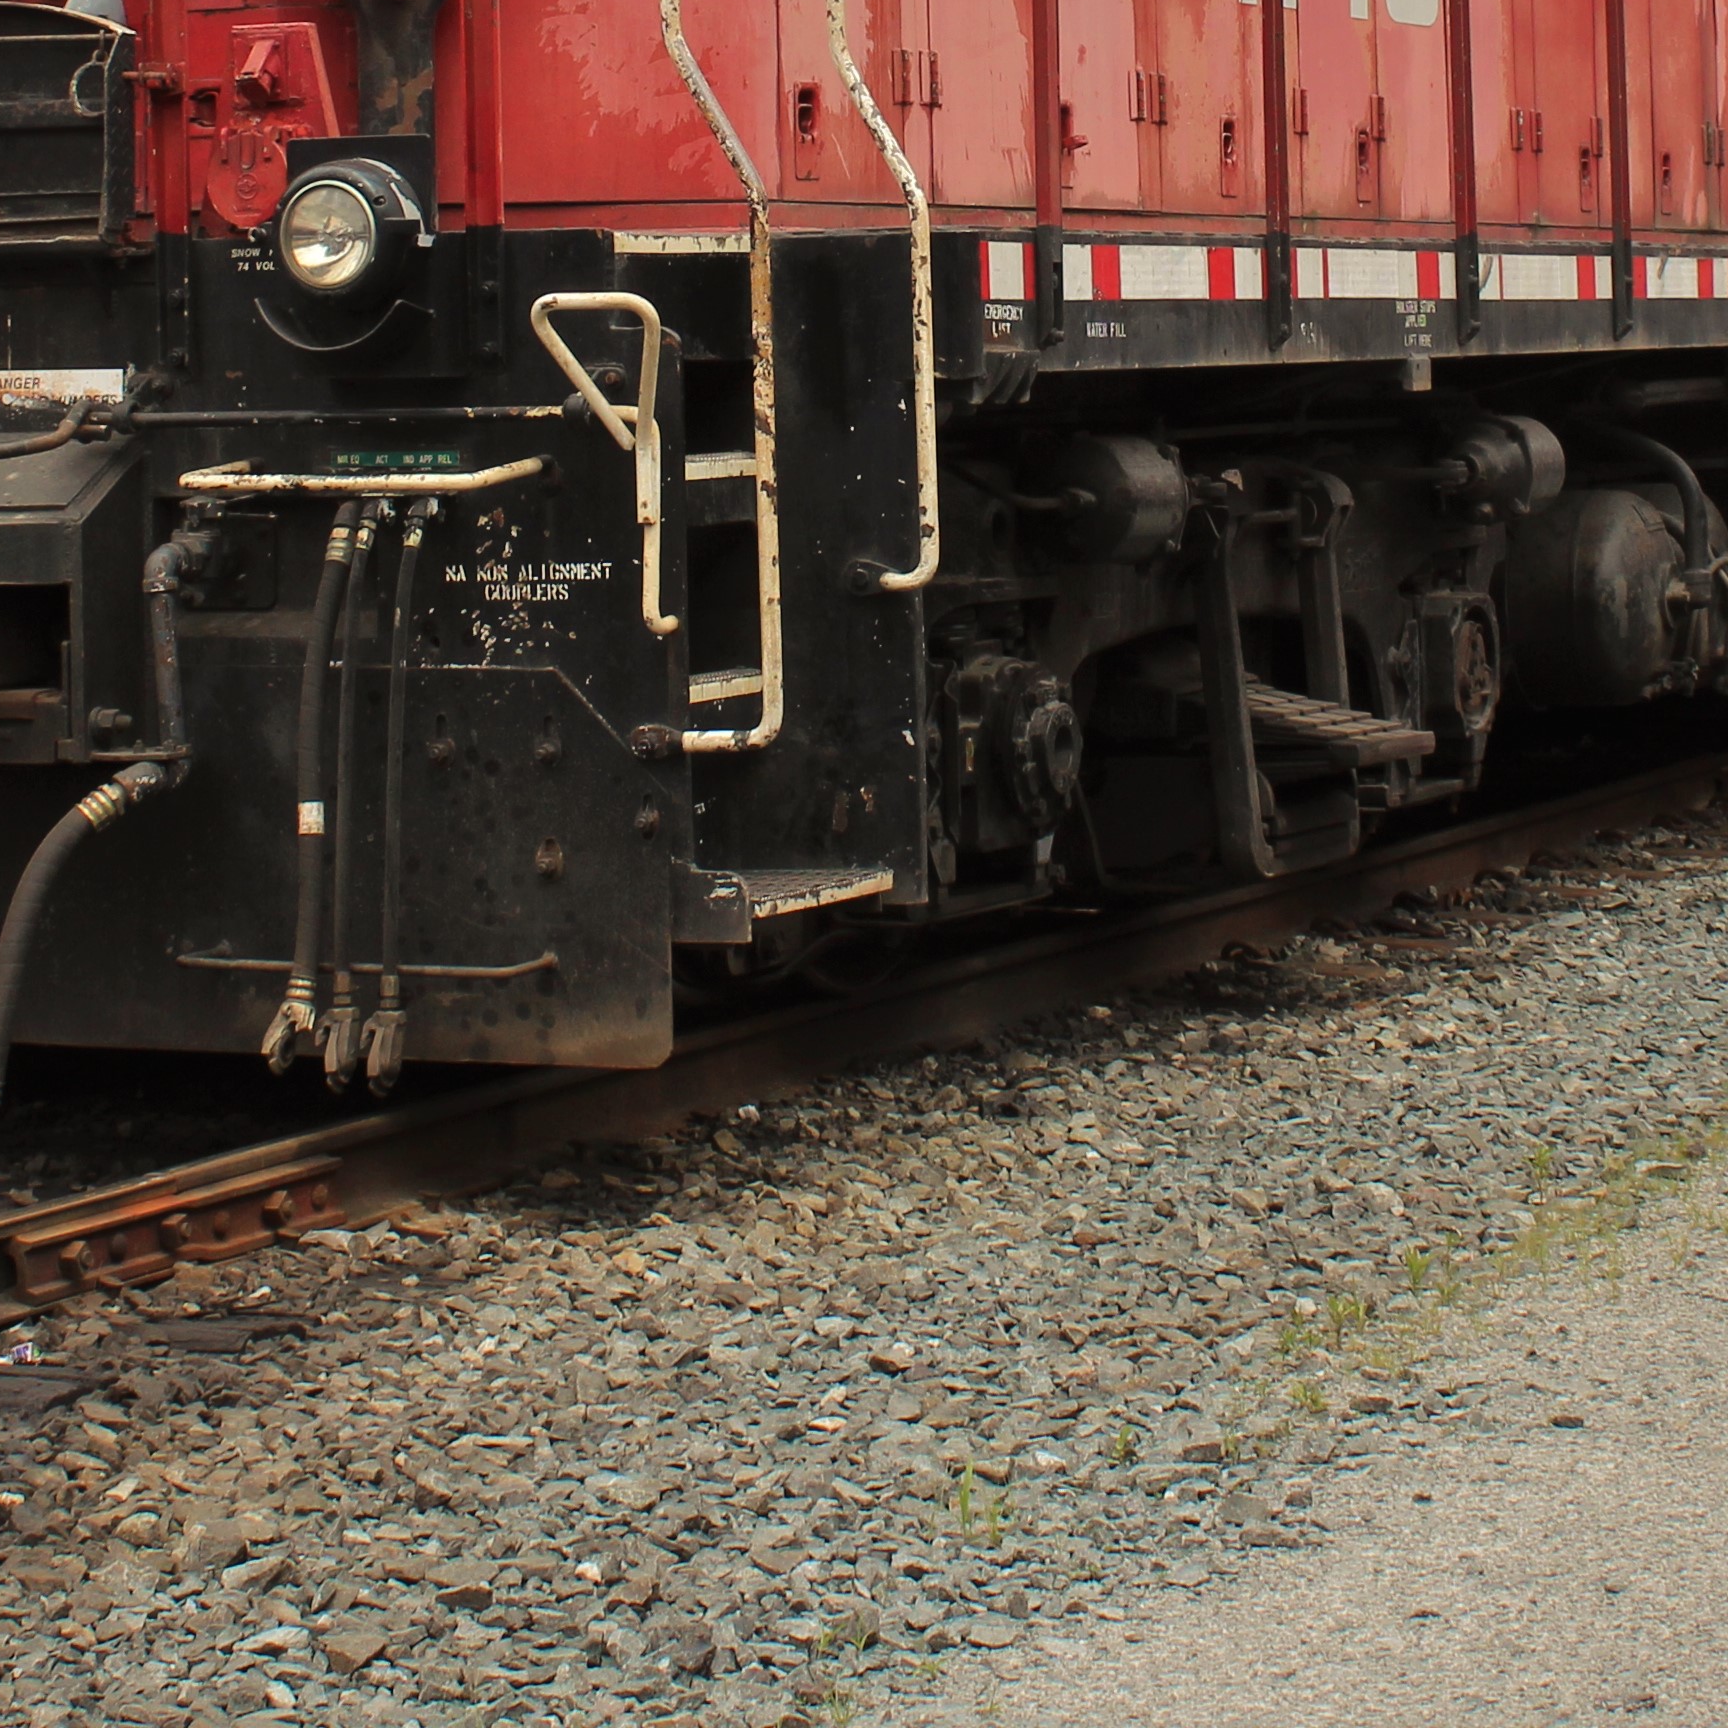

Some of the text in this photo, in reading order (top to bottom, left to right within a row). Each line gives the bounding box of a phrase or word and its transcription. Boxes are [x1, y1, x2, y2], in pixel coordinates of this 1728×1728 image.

[231, 248, 261, 259] SNOW
[237, 262, 250, 272] 74
[984, 303, 1024, 321] EMERGENCY
[1086, 322, 1127, 338] WATER FILL
[375, 454, 389, 465] ACT
[419, 454, 434, 464] APP
[437, 454, 452, 465] REL
[476, 563, 509, 582] NON
[518, 562, 613, 582] ALIGNMENT
[484, 583, 570, 602] COUPLERS
